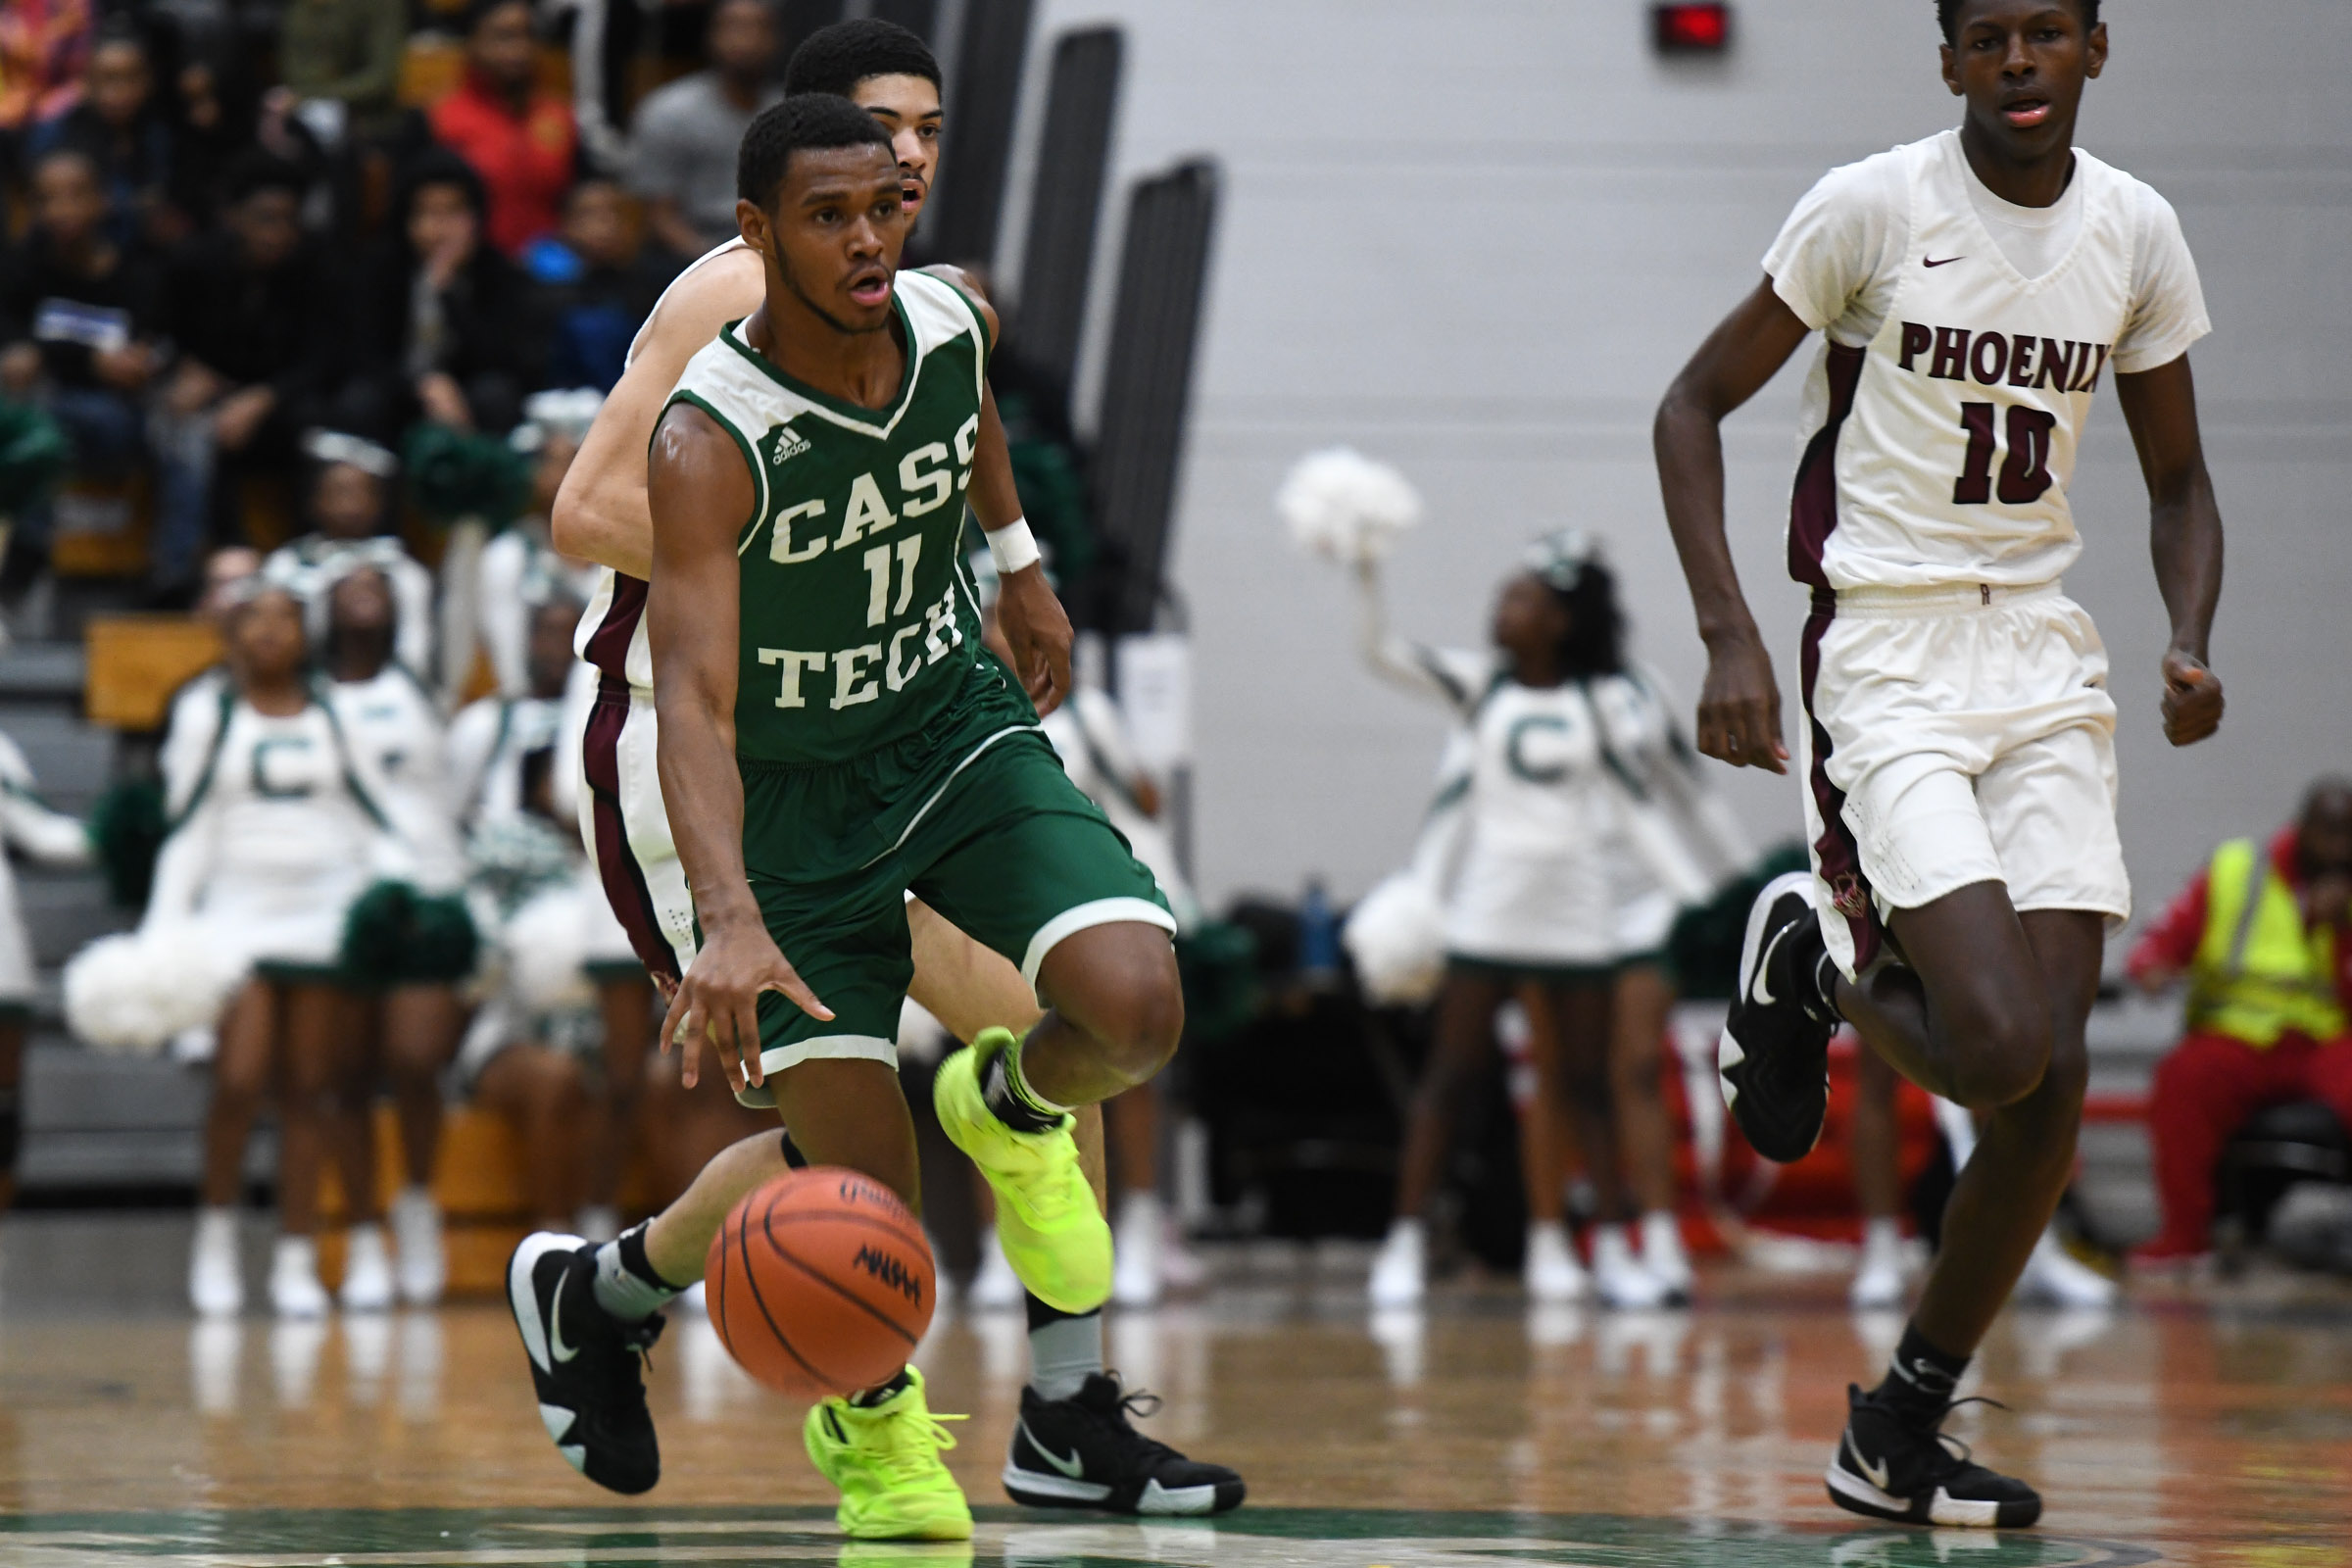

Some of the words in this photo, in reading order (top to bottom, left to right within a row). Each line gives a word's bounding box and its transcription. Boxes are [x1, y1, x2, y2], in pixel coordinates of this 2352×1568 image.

[769, 412, 979, 564] CASS
[772, 438, 811, 466] adidas
[1952, 400, 2057, 505] 10
[862, 532, 922, 628] 11
[757, 580, 963, 710] TECH
[251, 735, 316, 802] C
[1505, 712, 1574, 784] C
